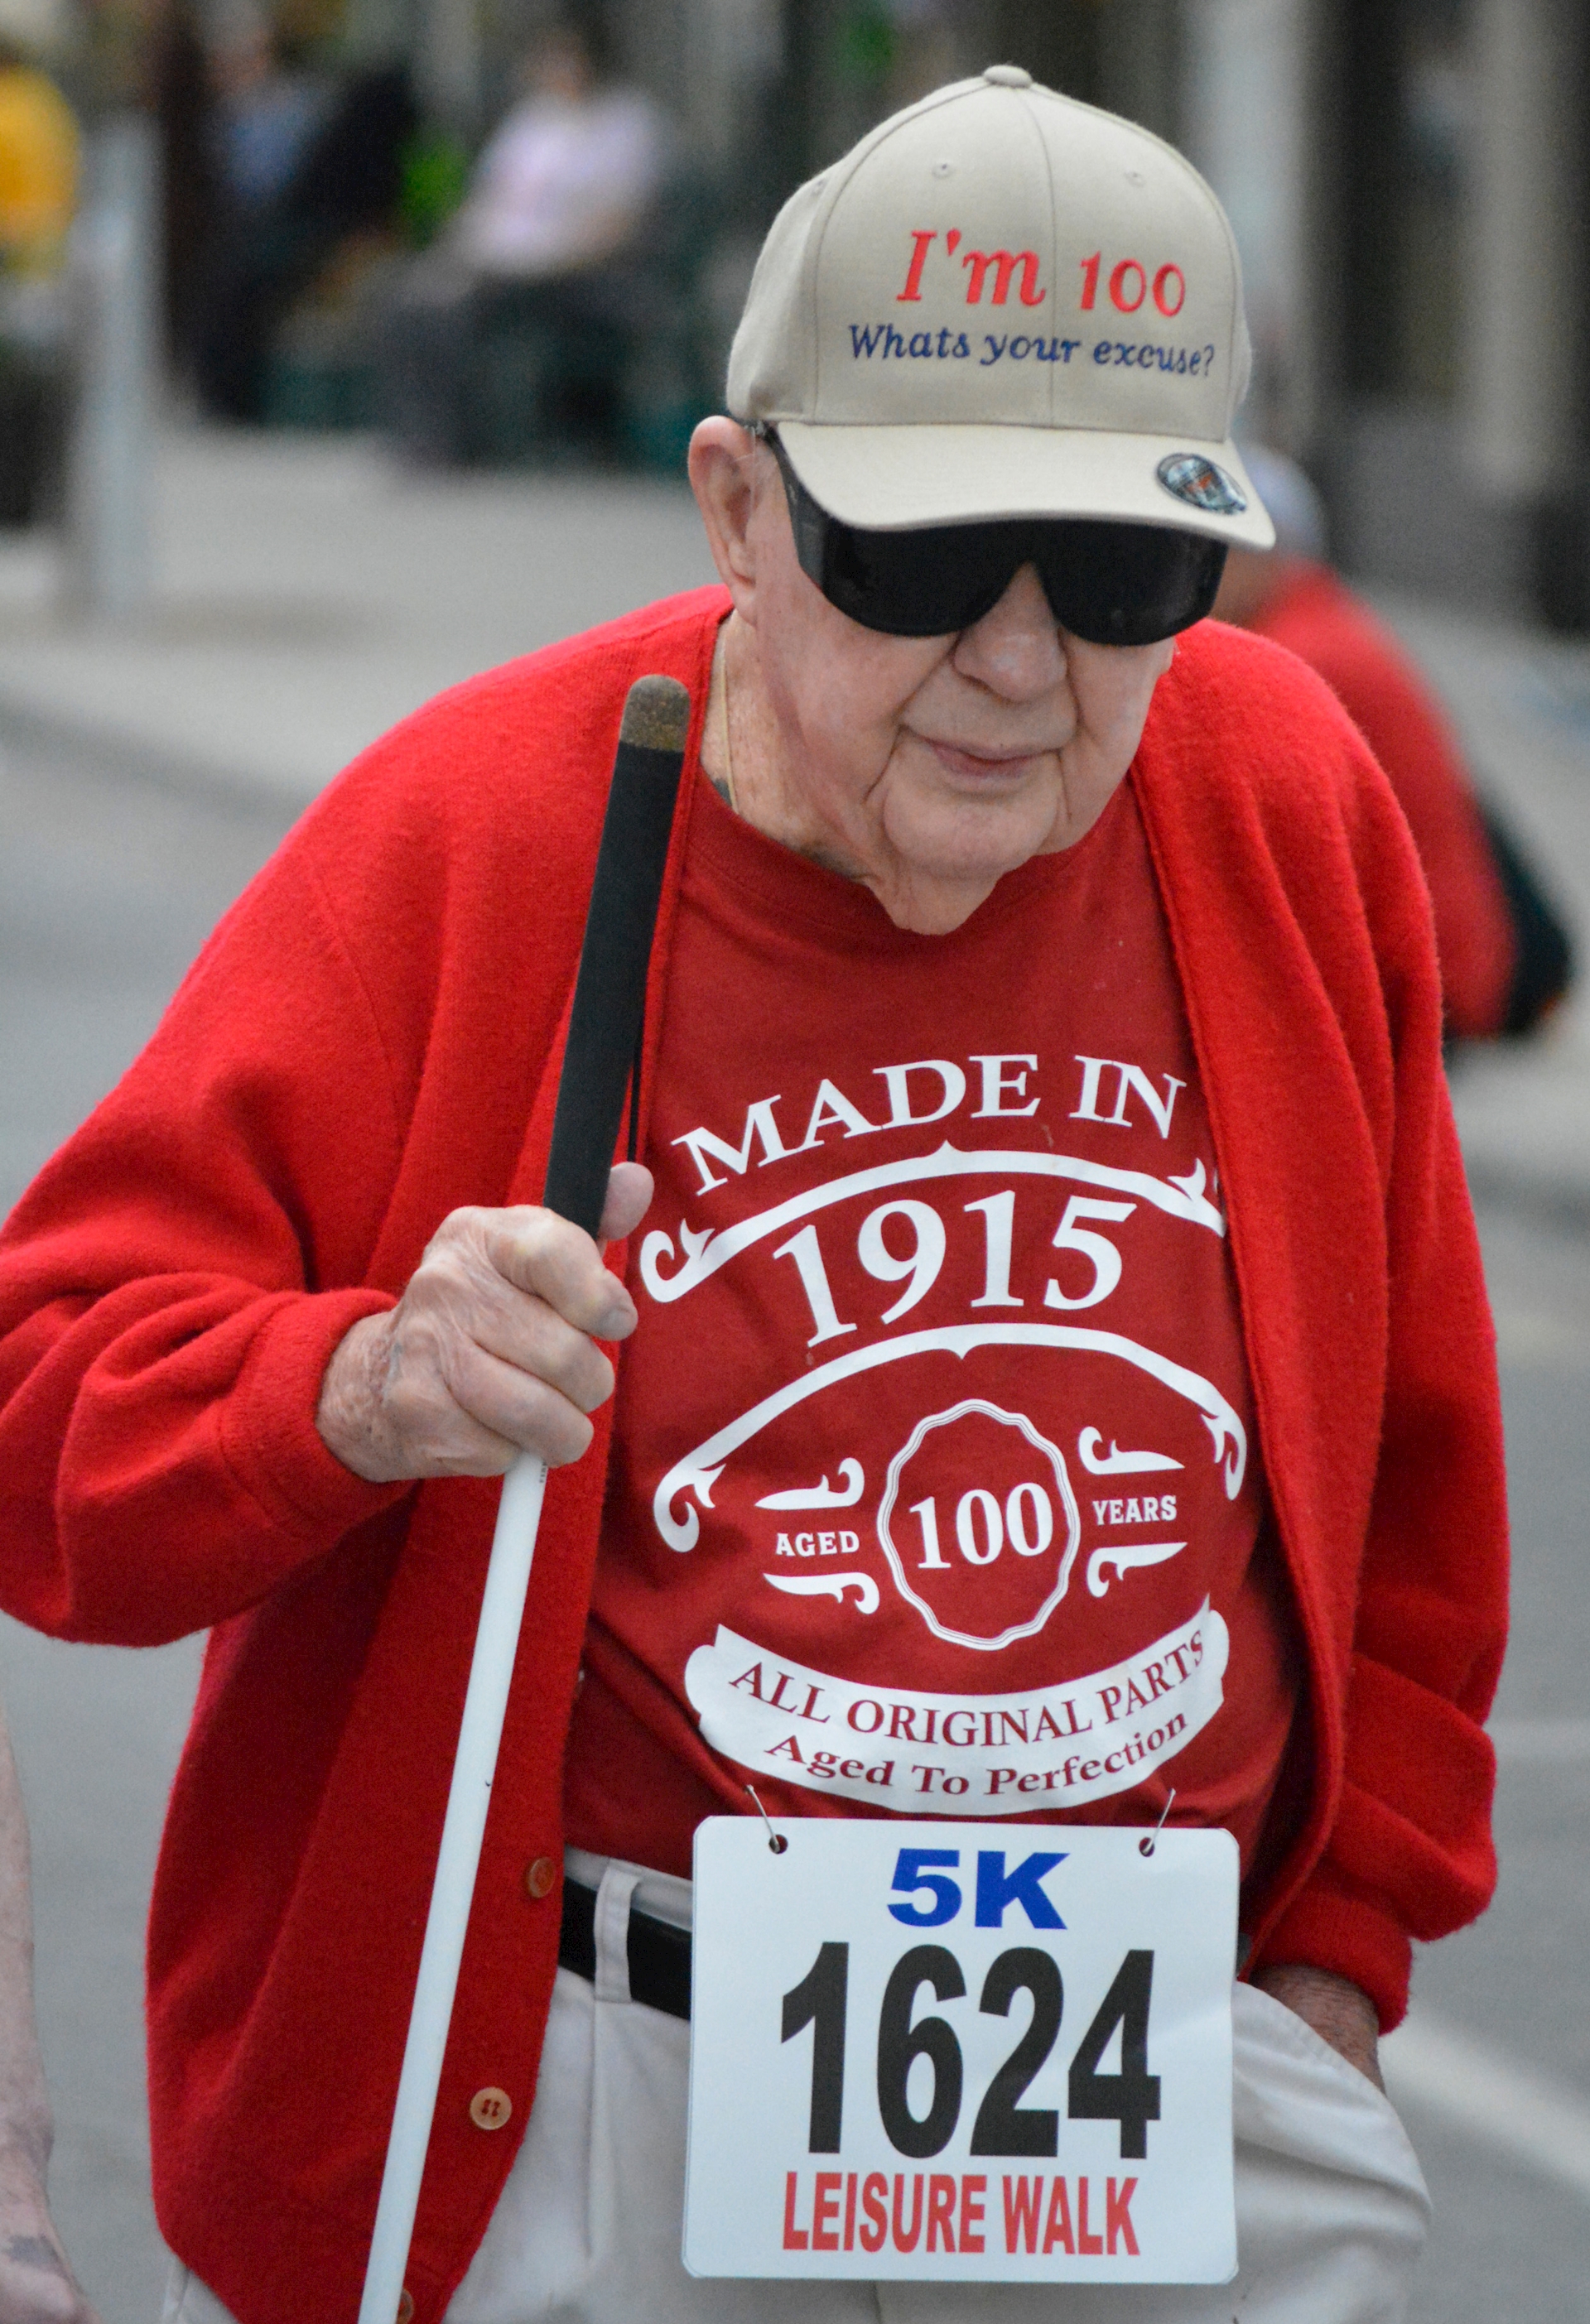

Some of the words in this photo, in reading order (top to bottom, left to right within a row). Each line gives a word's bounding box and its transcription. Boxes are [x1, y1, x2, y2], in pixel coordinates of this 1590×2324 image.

[897, 228, 1046, 307] I'm
[1080, 251, 1186, 317] 100
[849, 324, 970, 358] Whats
[980, 334, 1080, 366] your
[1093, 344, 1216, 377] excuse?
[671, 1053, 1042, 1196] MADE
[1069, 1054, 1187, 1139] IN
[773, 1190, 1138, 1348] 1915
[776, 1530, 860, 1557] AGED
[909, 1482, 1053, 1569] 100
[1092, 1494, 1178, 1526] YEARS
[730, 1661, 831, 1724] ALL
[846, 1698, 1092, 1748] ORIGINAL
[1097, 1629, 1205, 1724] PARTS
[764, 1734, 894, 1787] Aged
[911, 1764, 970, 1795] To
[985, 1710, 1188, 1795] Perfection
[887, 1847, 1070, 1930] 5K
[781, 1941, 1161, 2159] 1624
[783, 2172, 988, 2253] LEISURE
[1002, 2175, 1140, 2256] WALK
